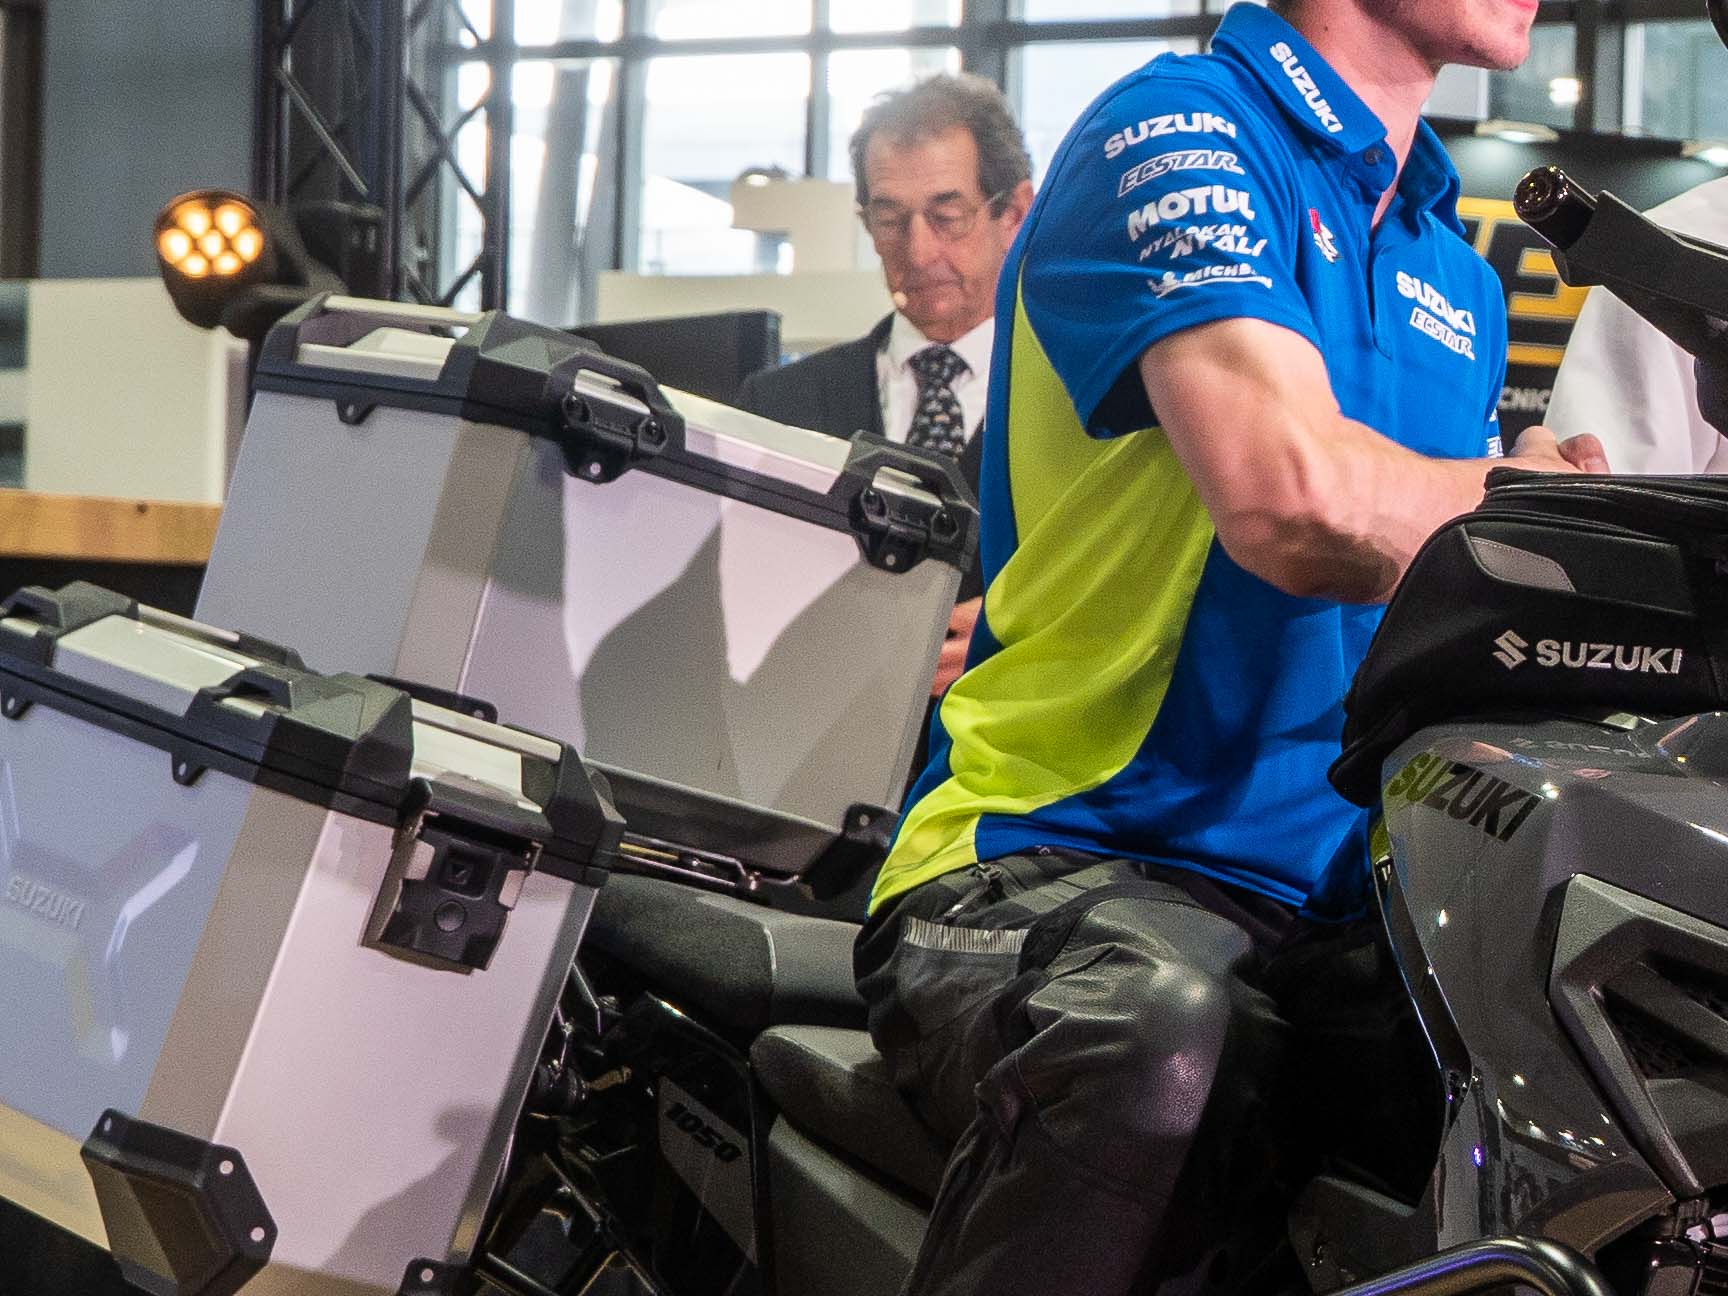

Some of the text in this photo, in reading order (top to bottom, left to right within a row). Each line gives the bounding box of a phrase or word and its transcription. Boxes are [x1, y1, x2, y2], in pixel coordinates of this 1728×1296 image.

[1269, 41, 1344, 134] SUZUKI
[1104, 112, 1237, 160] SUZUKI
[1116, 149, 1246, 199] ECSTAR
[1127, 185, 1256, 243] MOTUL
[1395, 270, 1477, 337] SUZUKI
[1535, 637, 1684, 677] SUZUKI
[1385, 751, 1544, 843] SUZUKI
[664, 1101, 743, 1164] 1050
